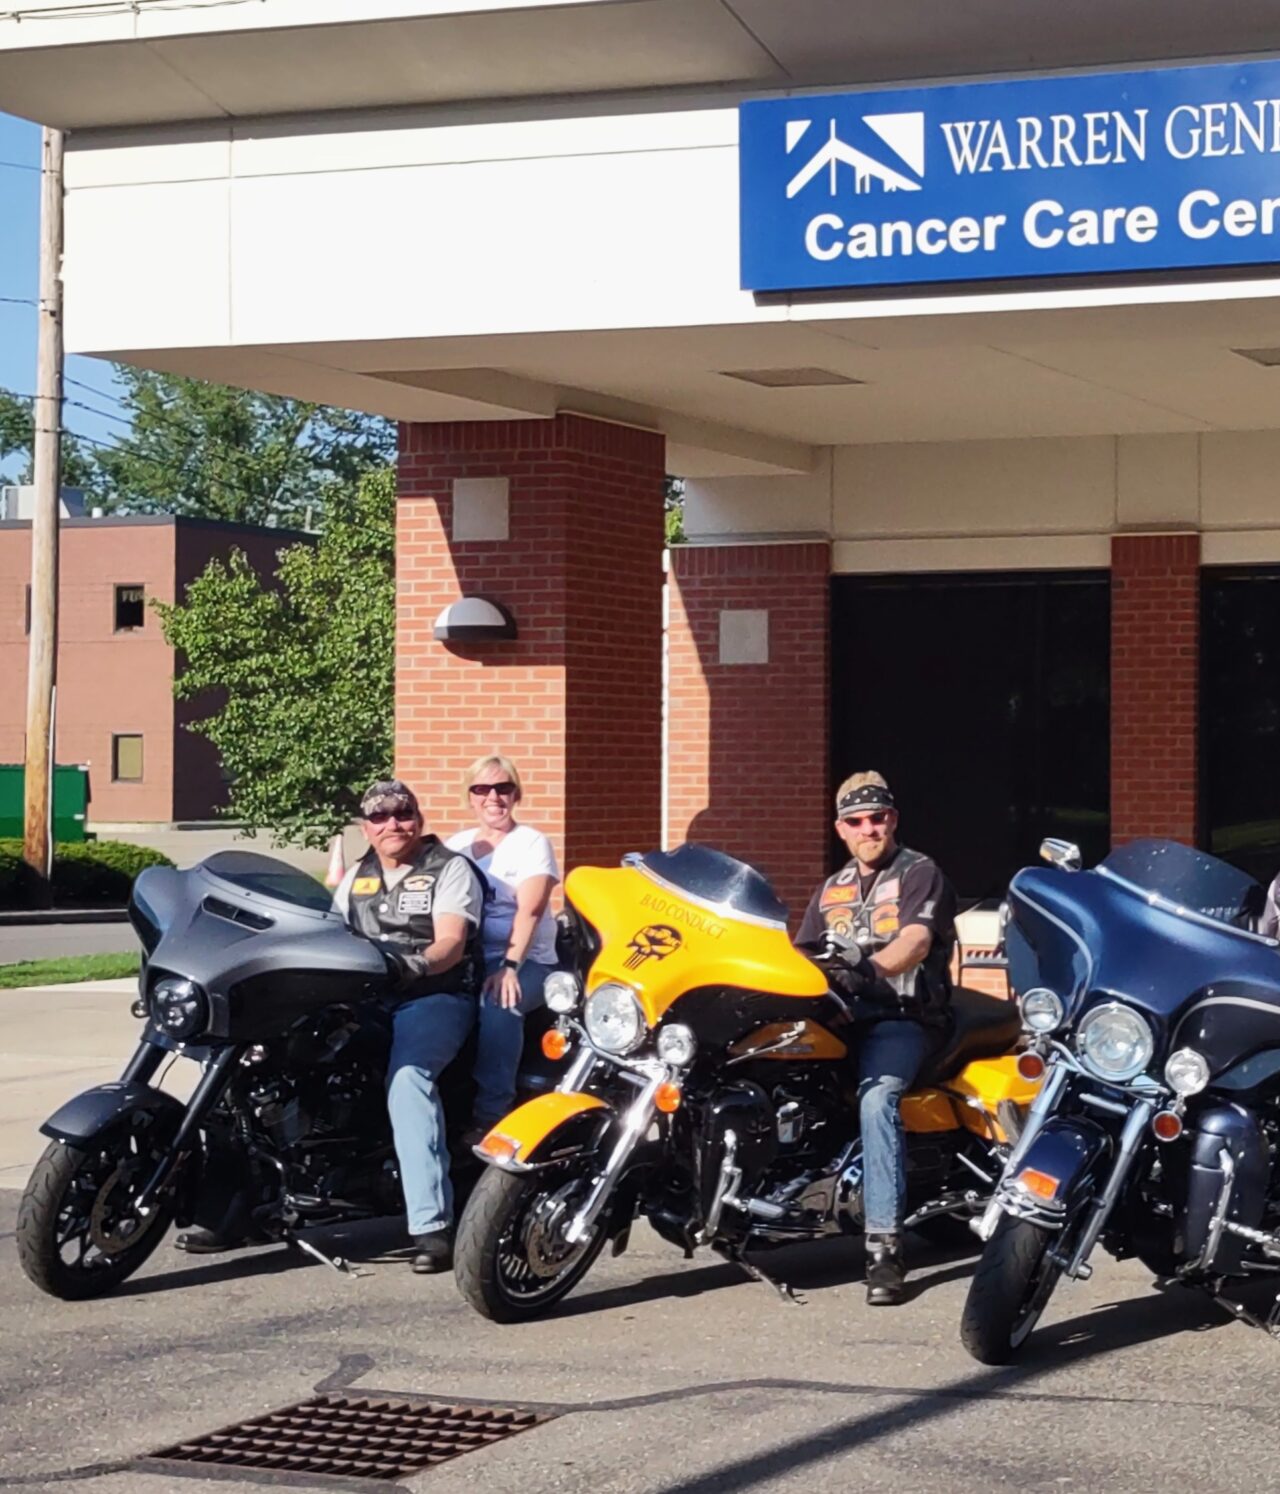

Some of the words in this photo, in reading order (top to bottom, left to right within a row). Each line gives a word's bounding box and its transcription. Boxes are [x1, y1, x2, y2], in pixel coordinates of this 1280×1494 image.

[940, 109, 1148, 175] WARREN
[804, 213, 1006, 261] Cancer
[1023, 199, 1159, 249] Care
[640, 893, 667, 912] BAD
[665, 903, 729, 940] CONDUCT
